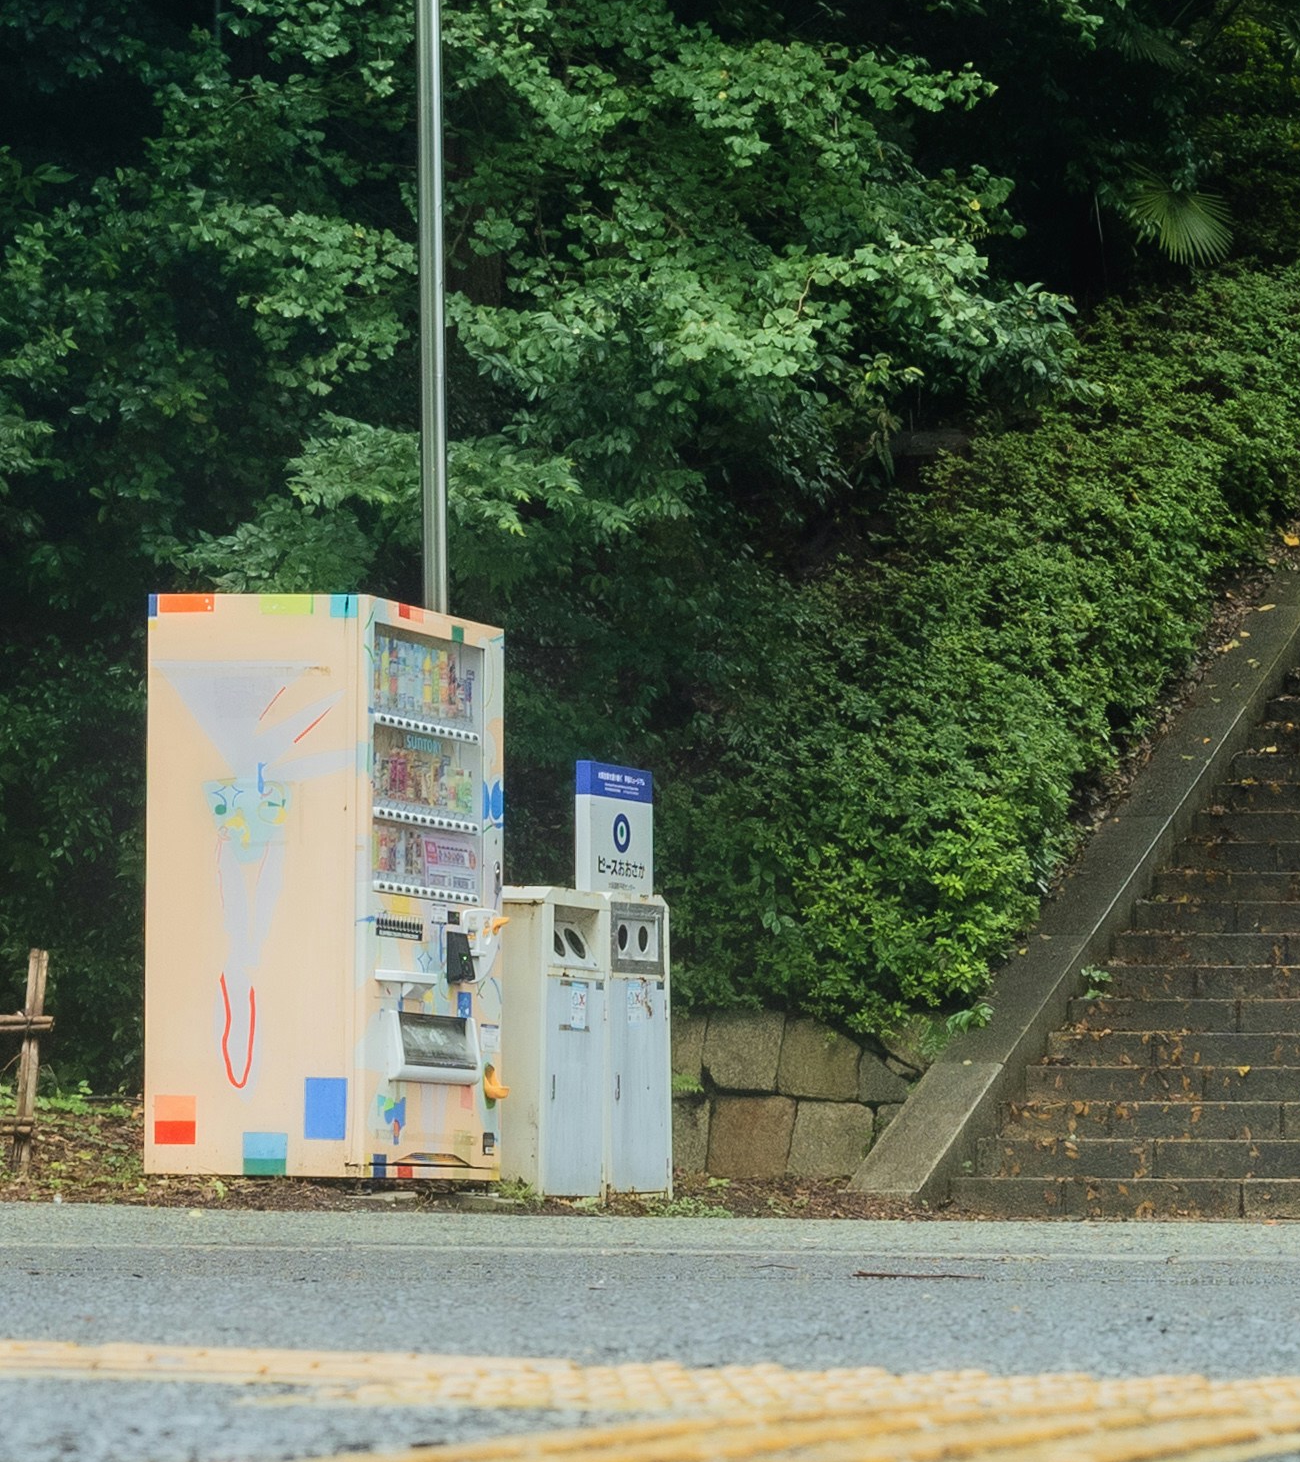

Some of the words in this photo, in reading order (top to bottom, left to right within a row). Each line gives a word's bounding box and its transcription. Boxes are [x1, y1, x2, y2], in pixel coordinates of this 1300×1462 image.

[598, 855, 645, 879] ピースおおさか
